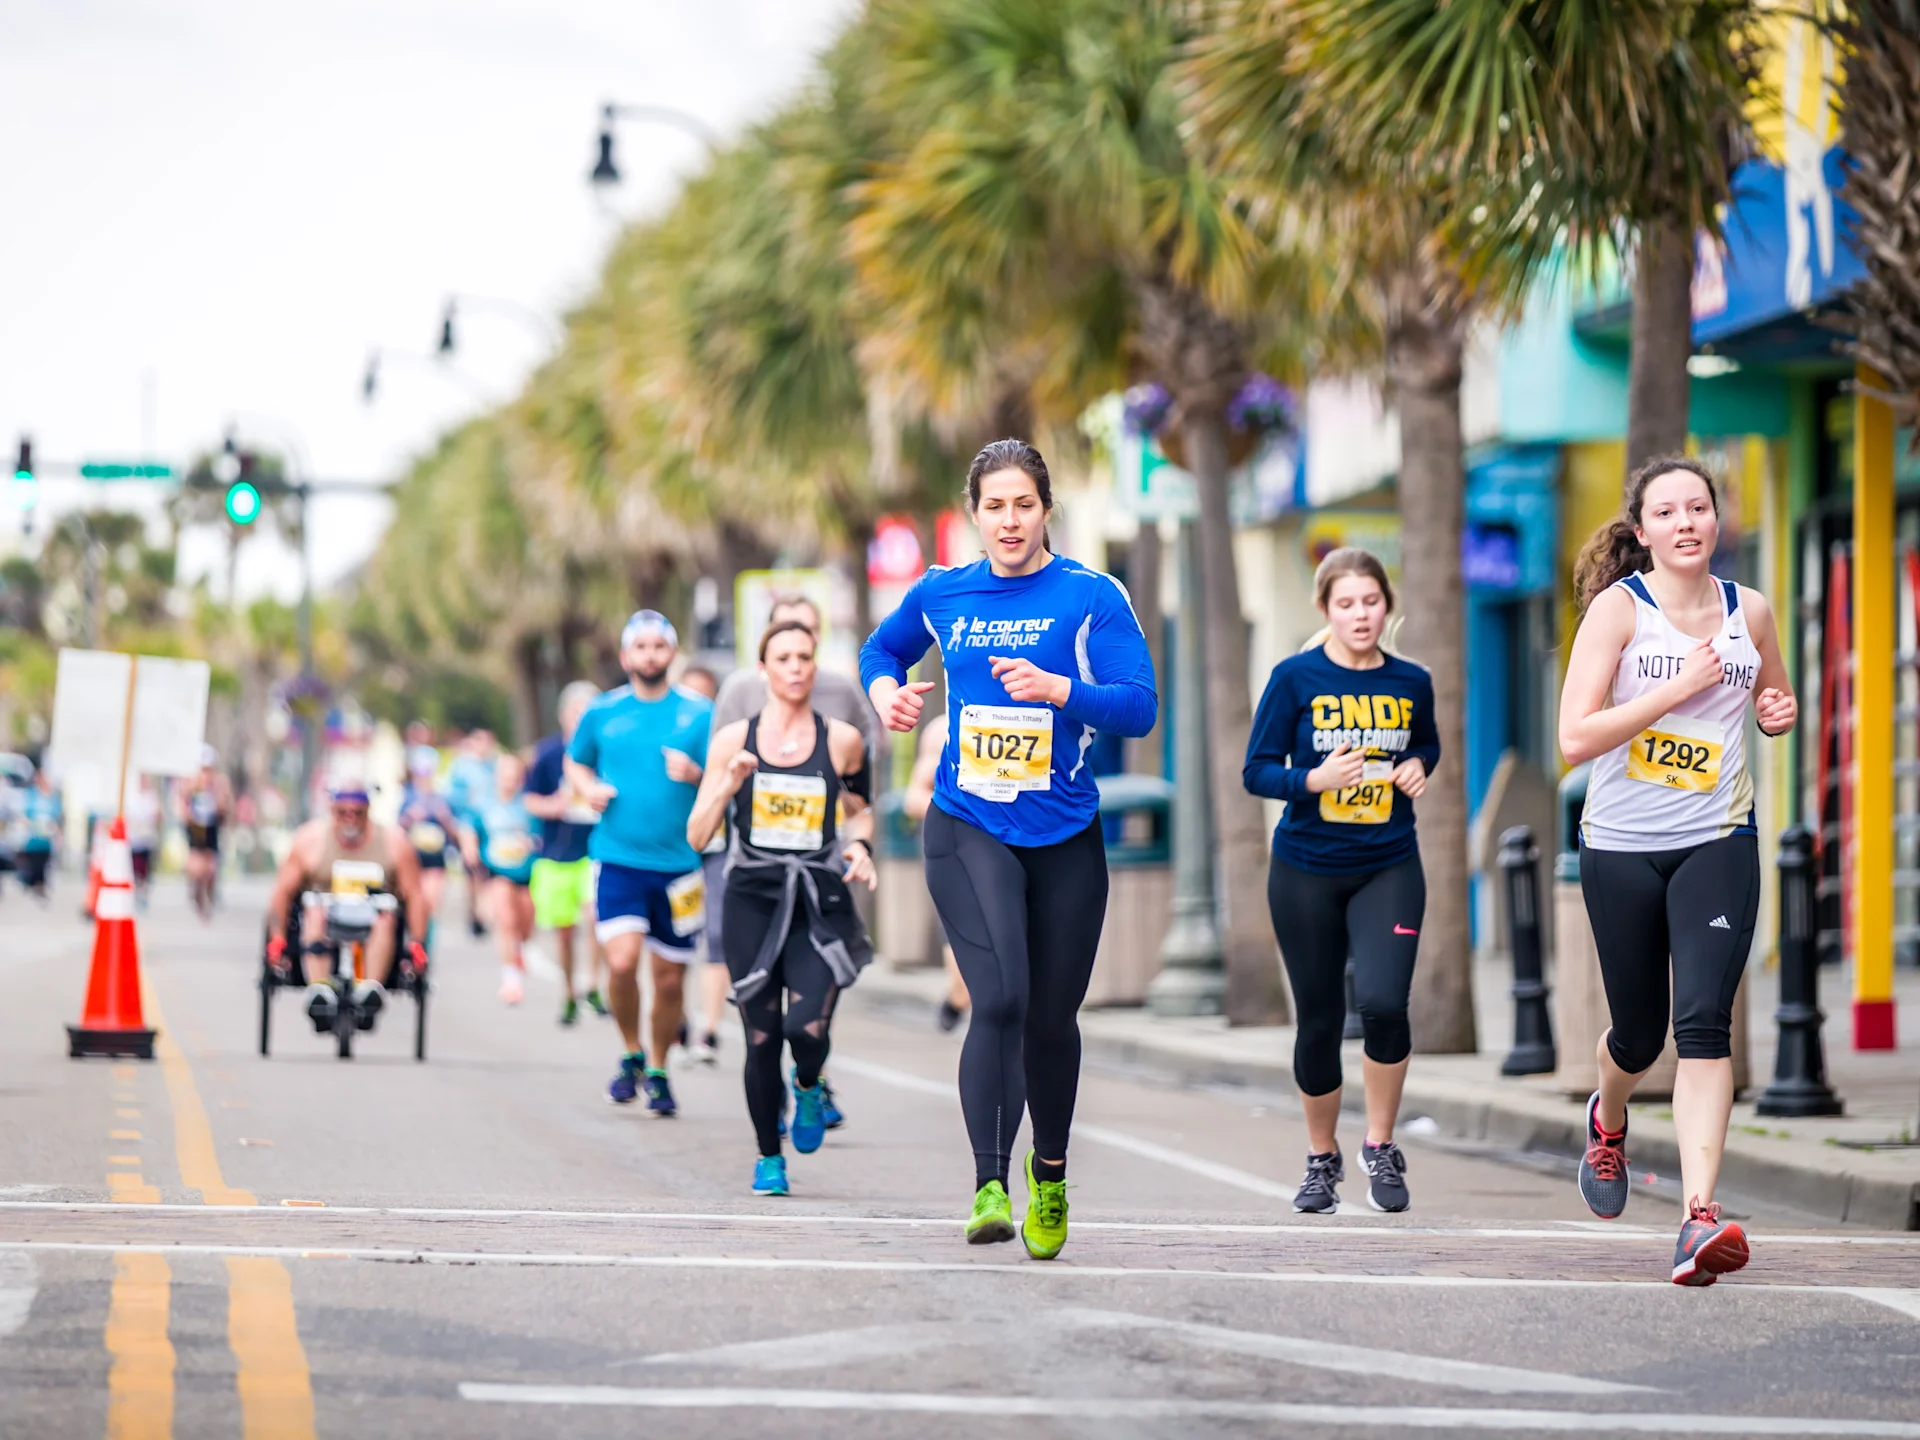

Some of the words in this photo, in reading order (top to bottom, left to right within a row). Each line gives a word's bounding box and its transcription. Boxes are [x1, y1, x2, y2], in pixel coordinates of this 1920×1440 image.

[969, 616, 987, 633] le
[987, 618, 1055, 633] coureur
[965, 631, 1040, 651] nordique
[1720, 662, 1754, 689] AME
[972, 732, 1039, 762] 1027
[1644, 736, 1709, 773] 1292
[997, 768, 1010, 778] 5K
[1665, 774, 1679, 785] 5K
[769, 795, 807, 817] 567
[1336, 784, 1385, 806] 1297
